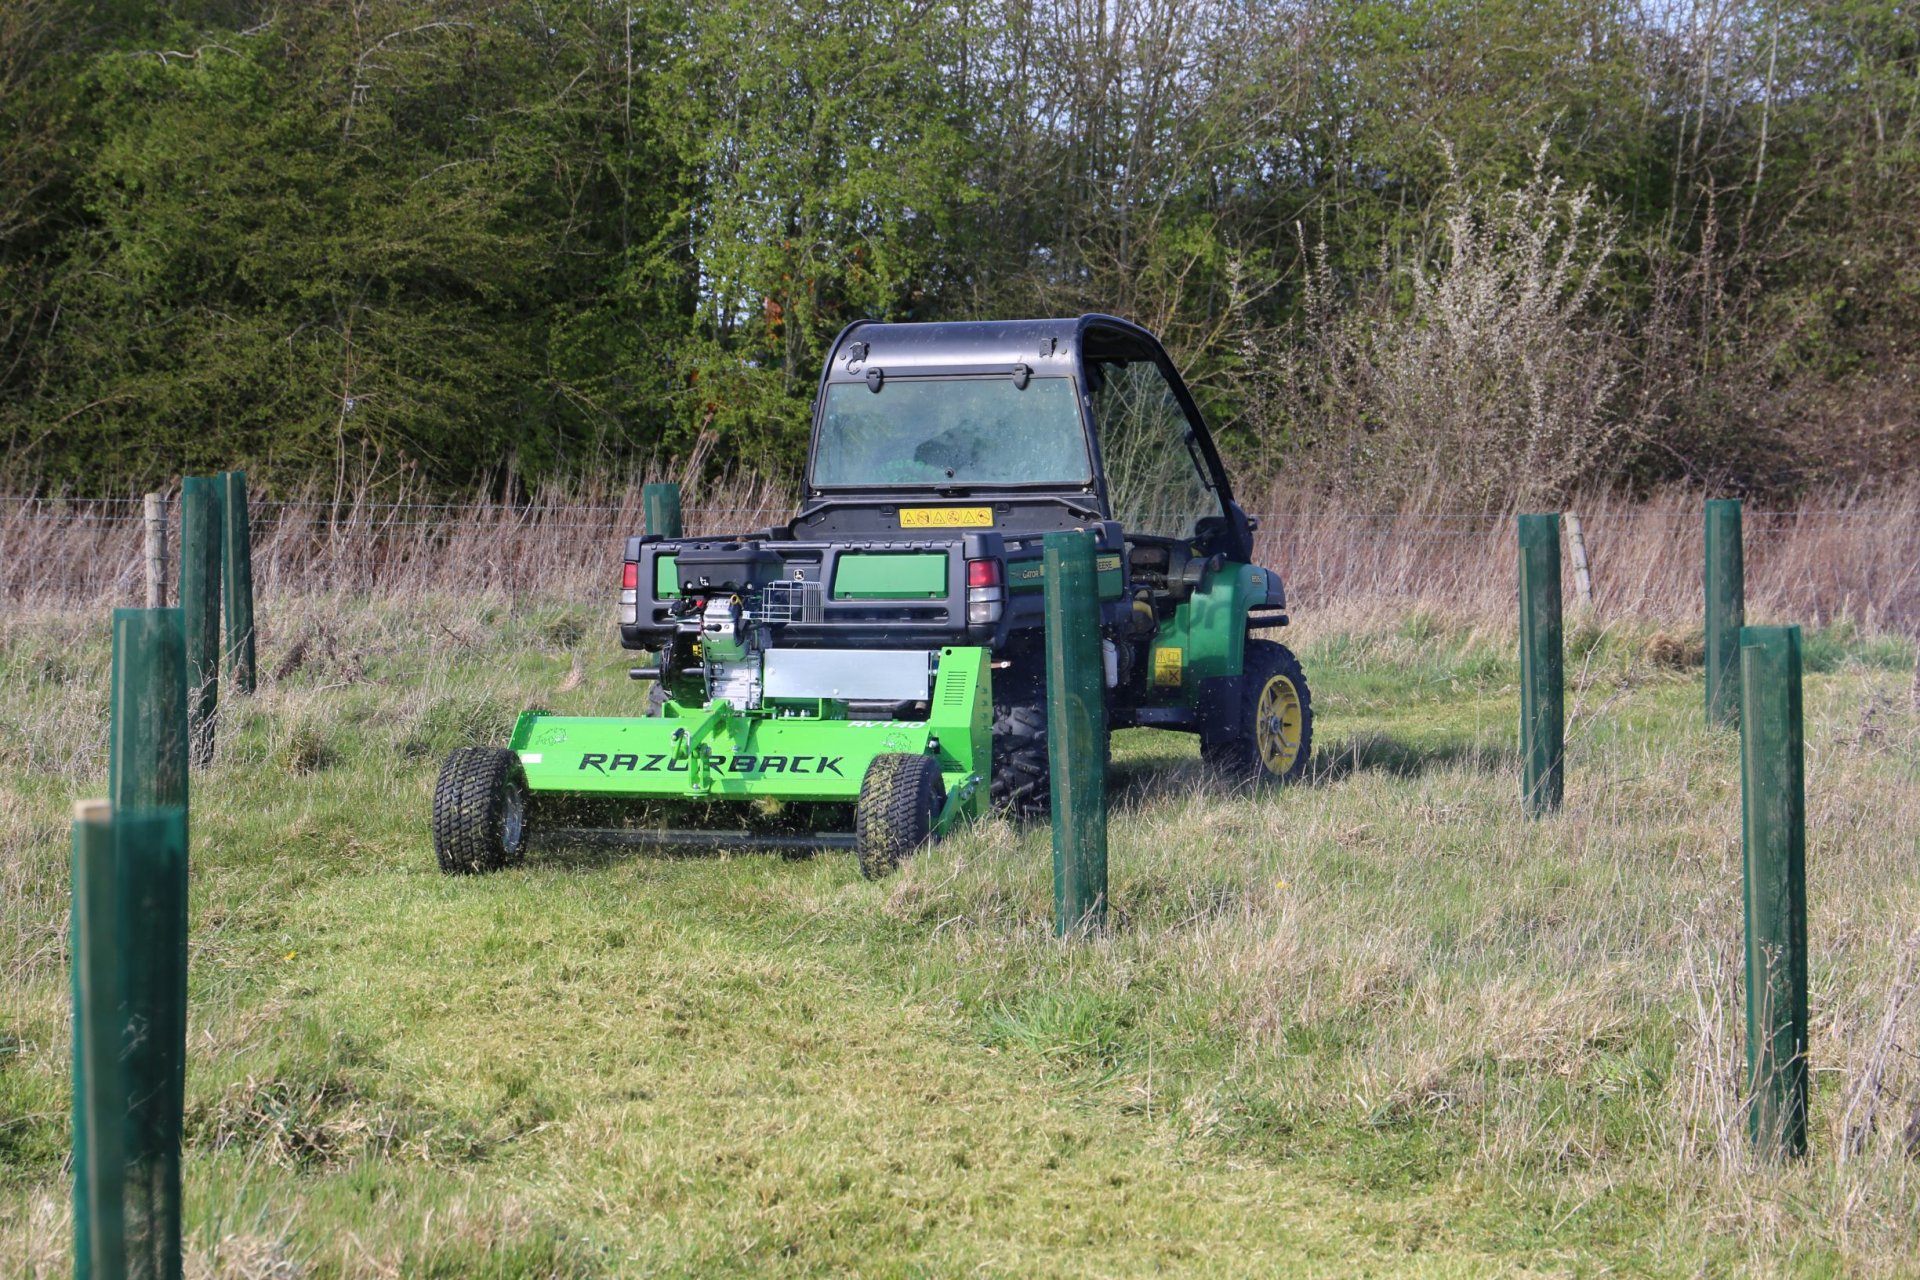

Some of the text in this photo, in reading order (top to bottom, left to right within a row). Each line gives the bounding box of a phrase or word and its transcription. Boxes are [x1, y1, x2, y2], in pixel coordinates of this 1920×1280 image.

[1023, 570, 1039, 578] GATOR
[848, 720, 926, 729] RV140
[578, 753, 845, 777] RAZORBACK
